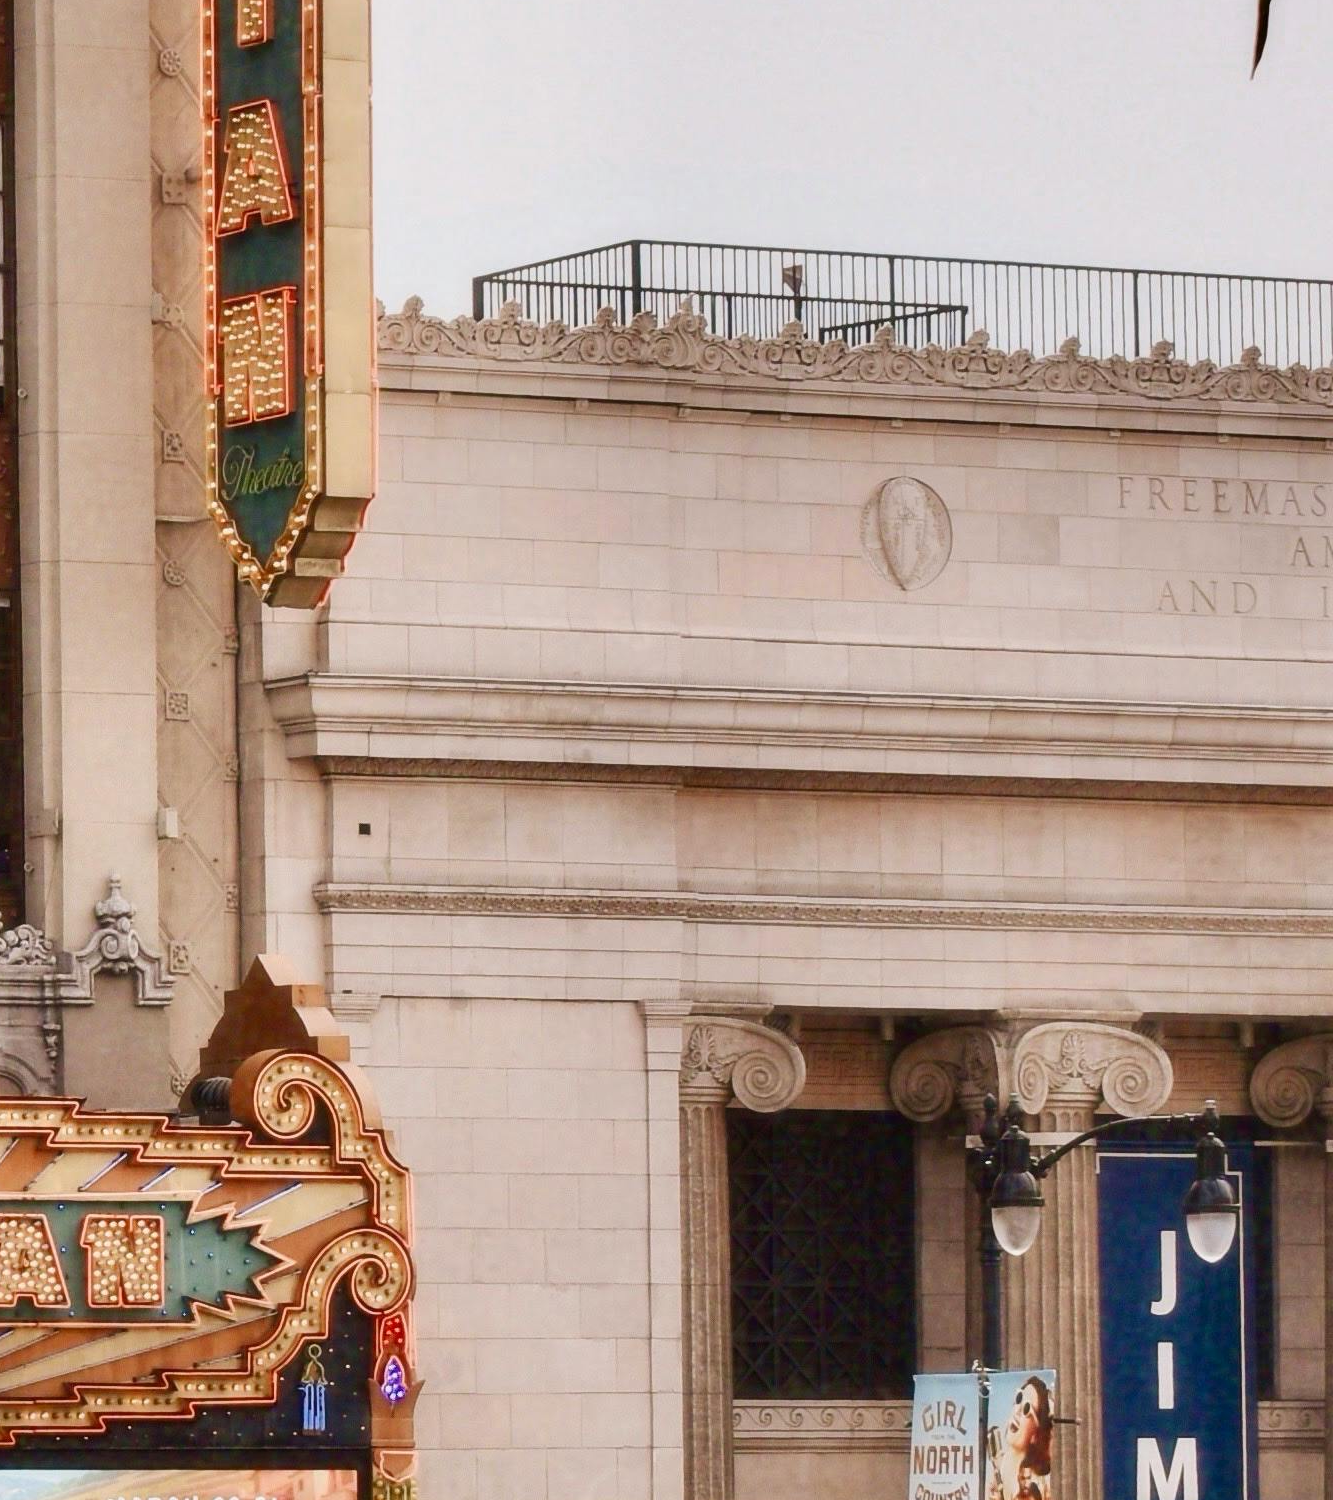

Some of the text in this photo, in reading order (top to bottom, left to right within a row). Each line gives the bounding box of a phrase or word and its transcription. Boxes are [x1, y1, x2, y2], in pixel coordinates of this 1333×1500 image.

[221, 444, 303, 501] Theatre
[1157, 579, 1258, 614] AND
[922, 1400, 968, 1435] GIRL
[913, 1445, 974, 1475] NORTH
